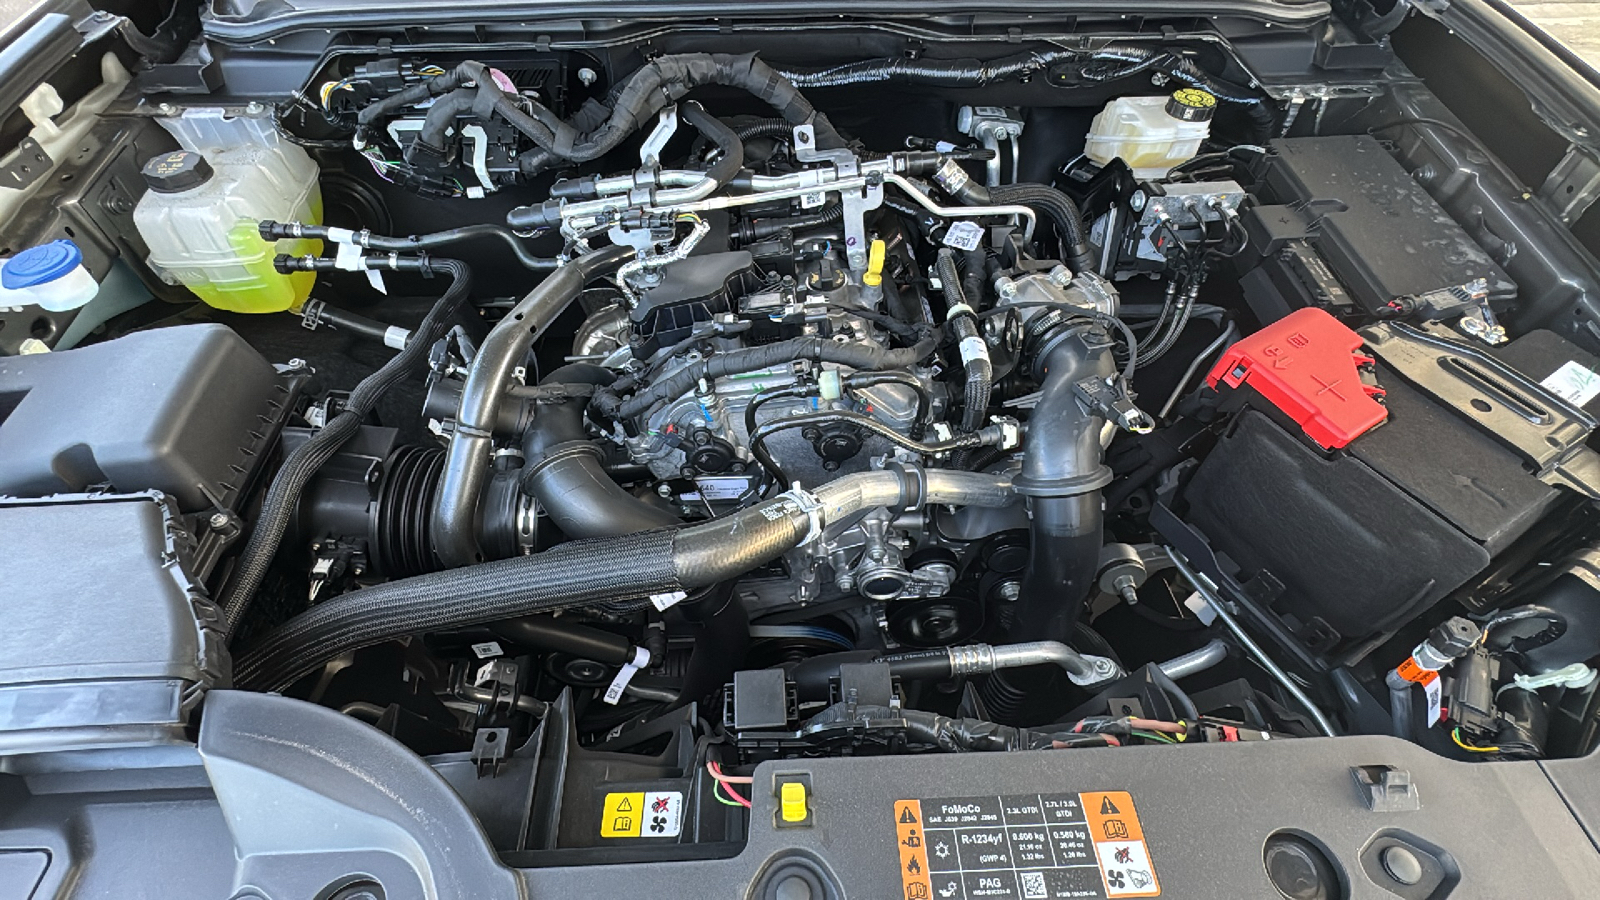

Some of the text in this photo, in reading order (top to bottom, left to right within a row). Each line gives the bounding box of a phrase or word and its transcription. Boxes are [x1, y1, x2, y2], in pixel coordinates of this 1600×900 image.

[941, 804, 980, 814] FoMoCo
[961, 832, 1003, 846] R-1234yf
[1034, 832, 1045, 842] kg
[1074, 830, 1086, 840] kg
[979, 878, 1002, 889] PAG
